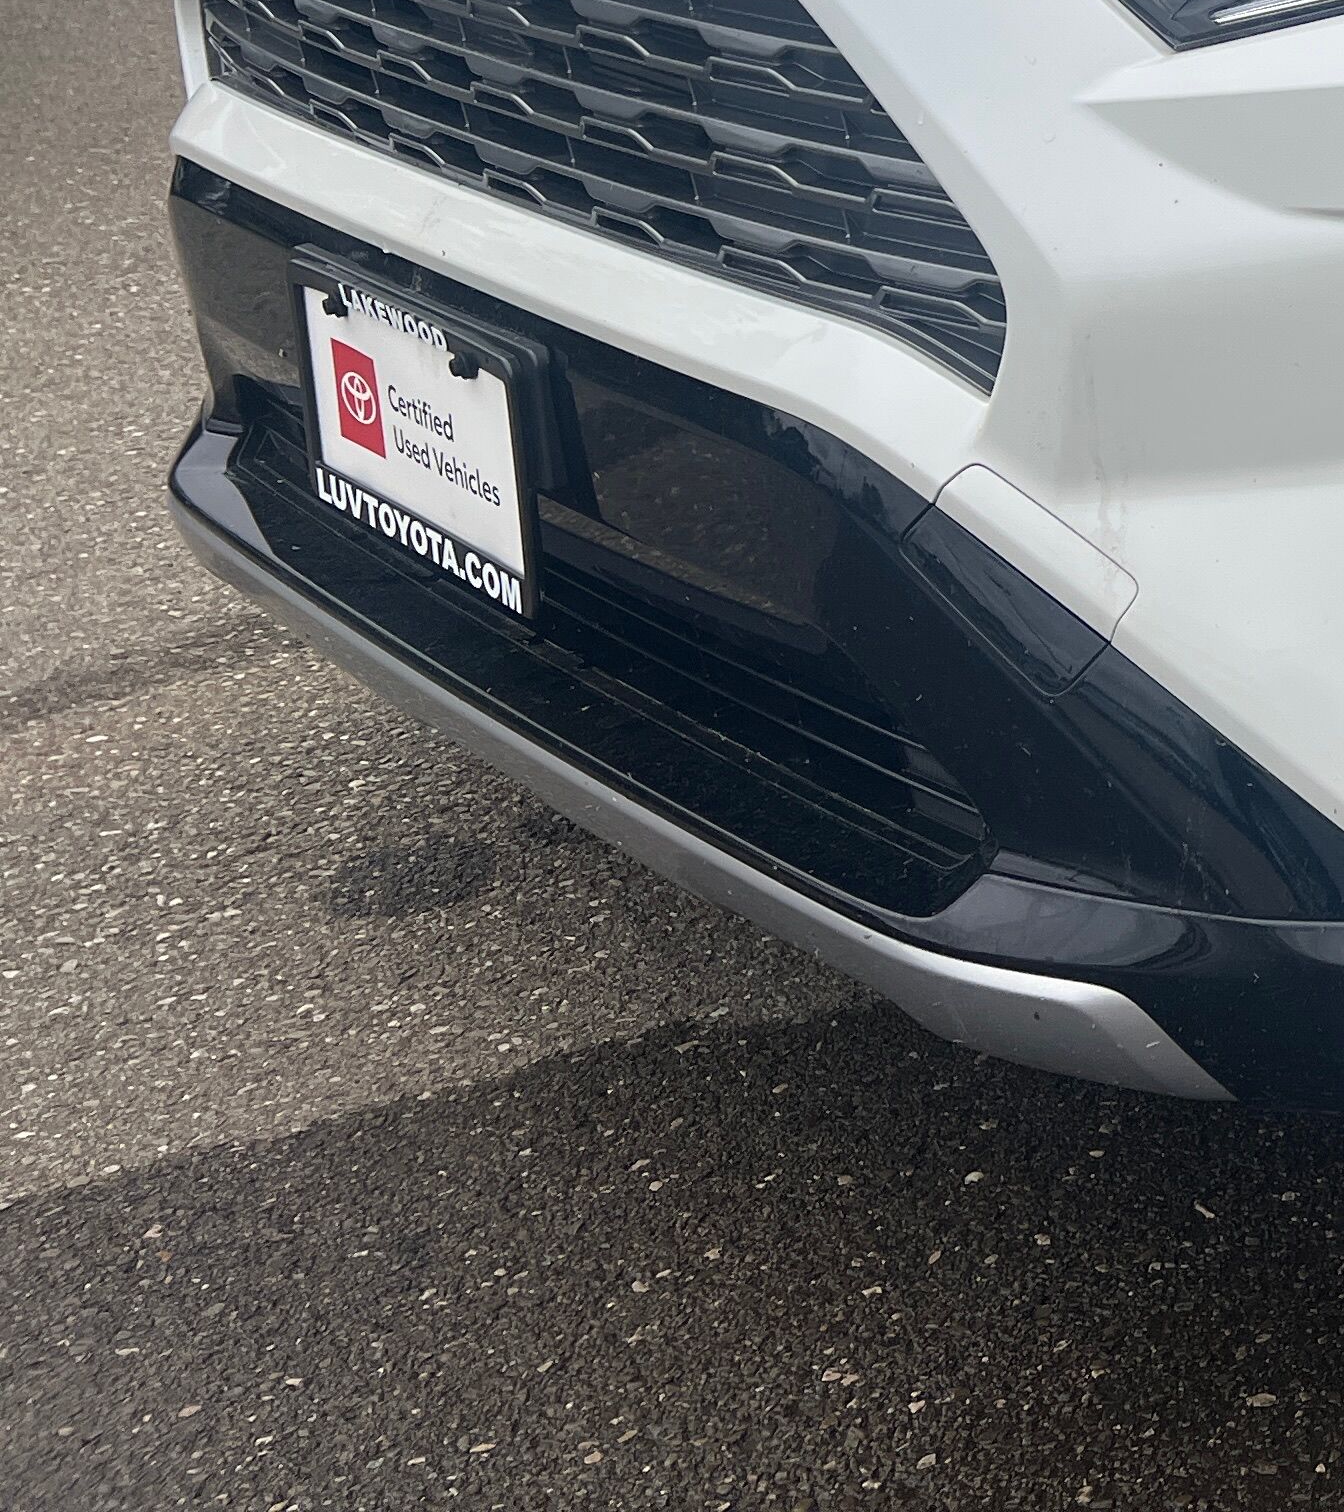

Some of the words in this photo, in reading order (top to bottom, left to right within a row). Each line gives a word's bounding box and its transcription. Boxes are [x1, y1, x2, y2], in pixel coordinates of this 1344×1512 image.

[338, 283, 449, 352] LAKEWOOD
[387, 384, 455, 443] Certified
[392, 424, 431, 471] Used
[431, 447, 502, 507] Vehicles
[315, 466, 523, 615] LUVTOYOTA.COM
